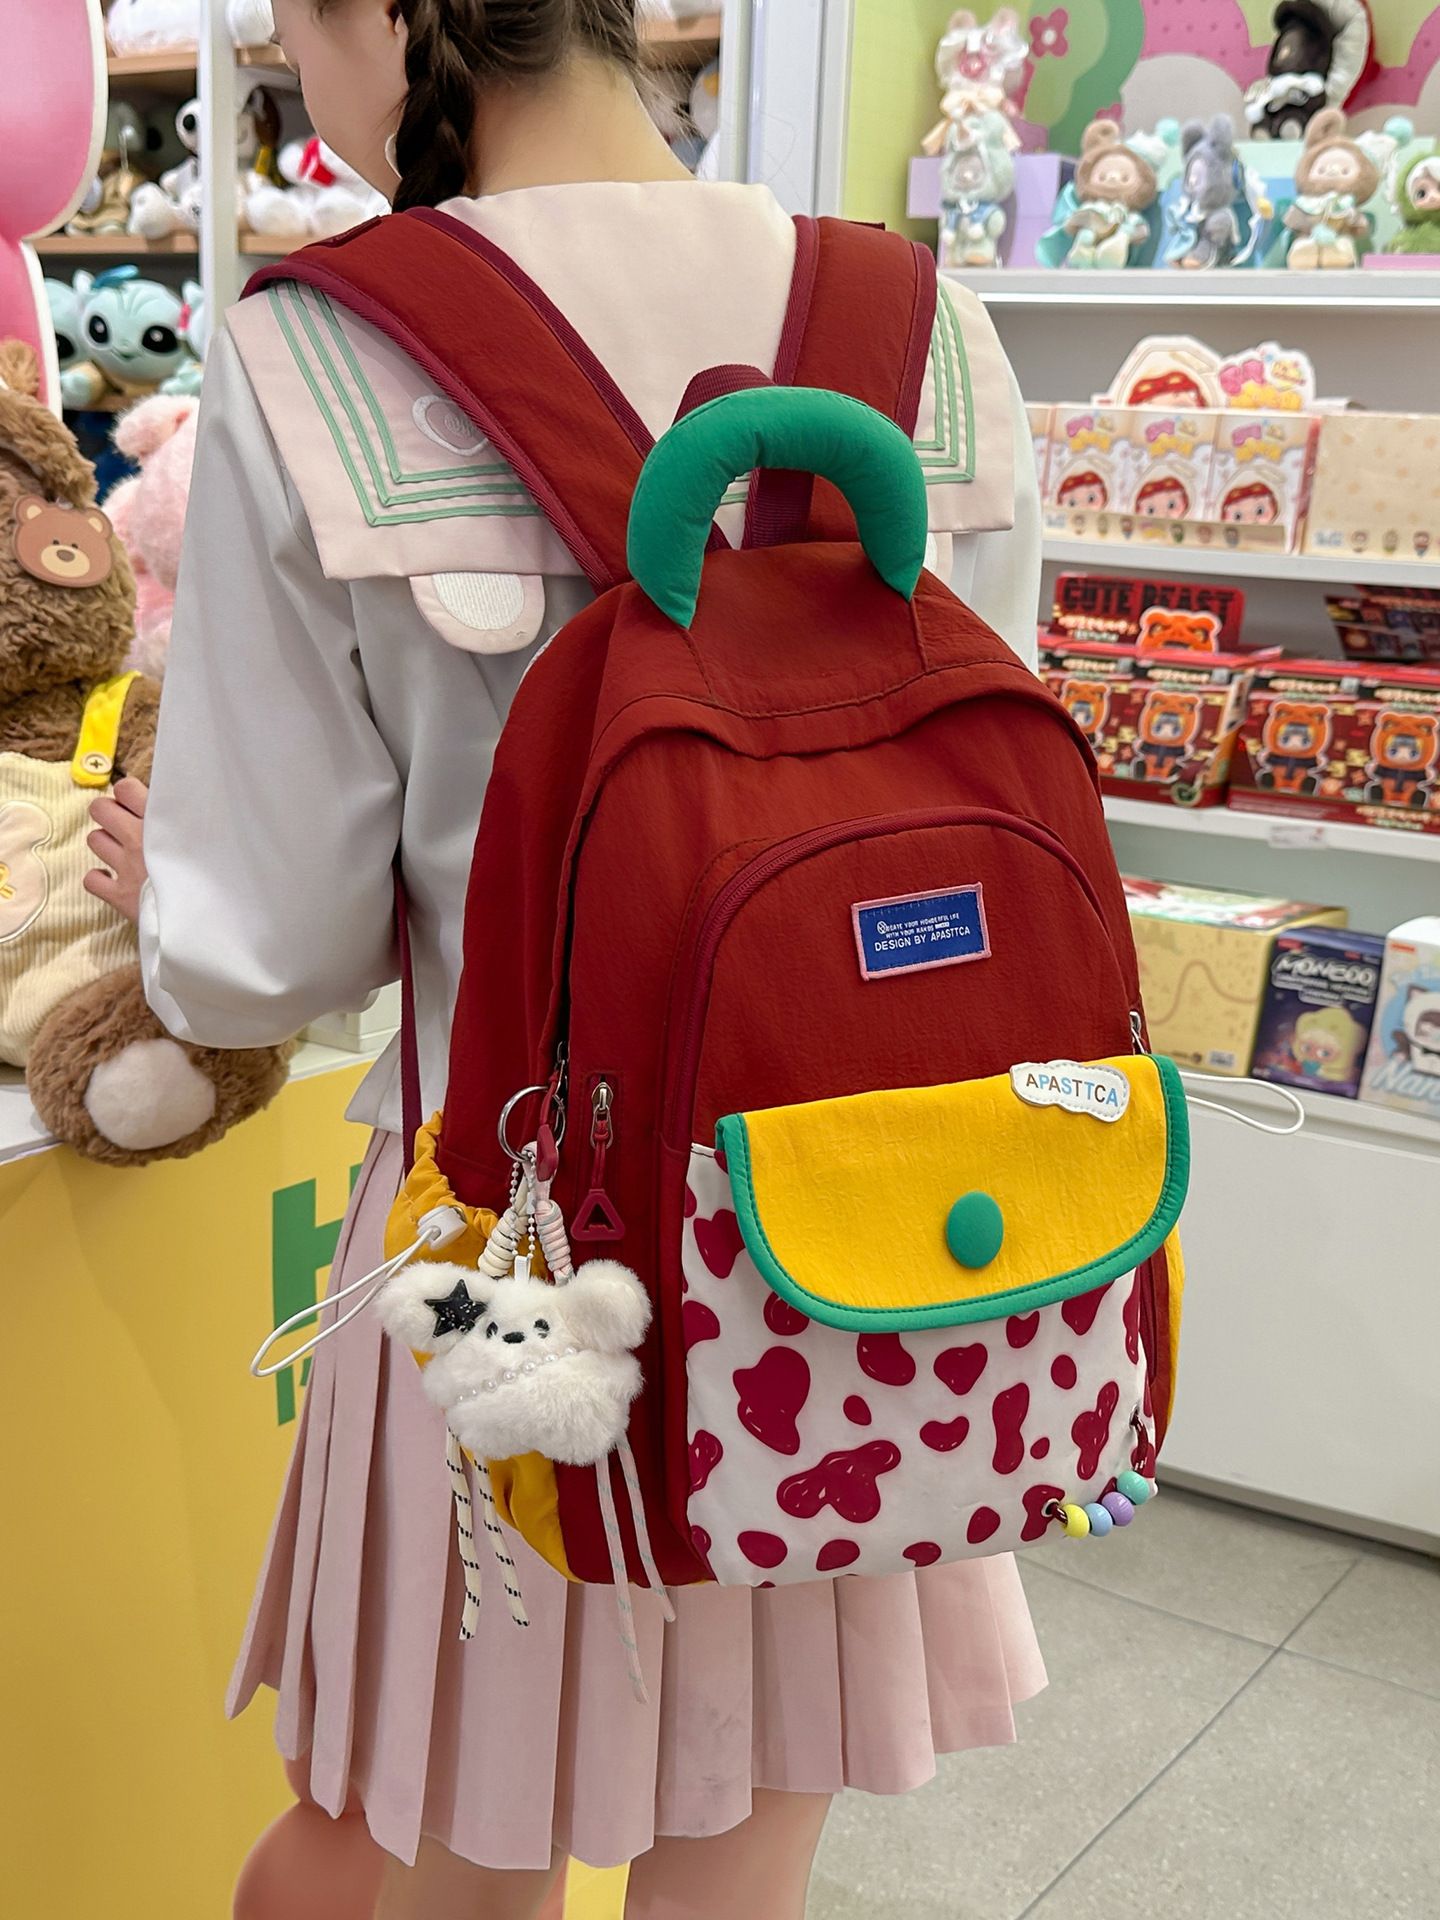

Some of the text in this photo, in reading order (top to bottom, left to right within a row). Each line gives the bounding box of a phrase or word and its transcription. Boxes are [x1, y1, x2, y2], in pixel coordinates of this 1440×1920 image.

[1063, 577, 1133, 614] CUTE
[874, 937, 912, 952] DESIGN
[914, 934, 927, 945] BY
[930, 925, 971, 942] APASTTCA
[1026, 1073, 1118, 1107] APASTTCA
